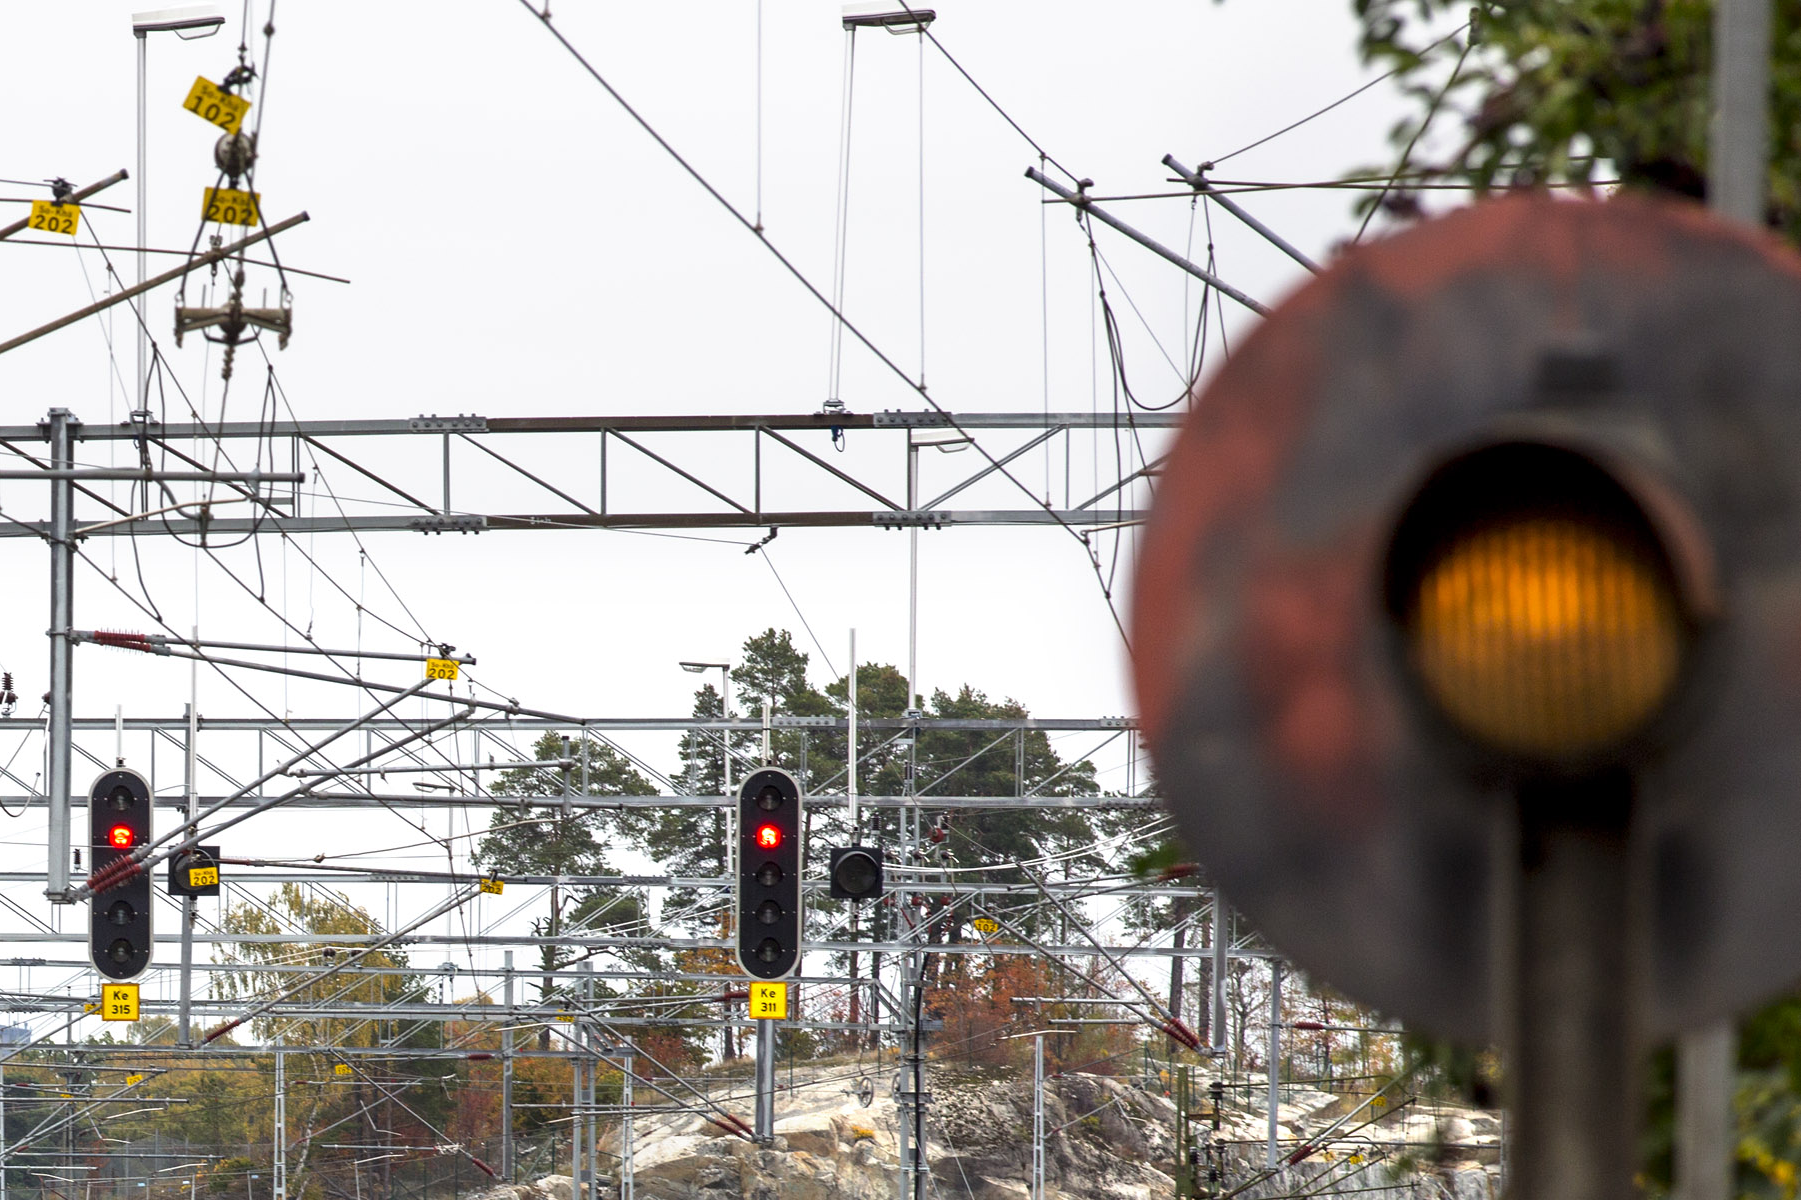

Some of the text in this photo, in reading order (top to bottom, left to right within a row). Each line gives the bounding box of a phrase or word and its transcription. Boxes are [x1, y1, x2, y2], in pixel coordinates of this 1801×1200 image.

[192, 96, 236, 130] 102
[207, 204, 254, 226] 202
[34, 214, 74, 234] 202
[429, 668, 455, 680] 202
[193, 876, 215, 885] 202
[481, 885, 501, 895] 202
[977, 923, 997, 932] 102
[113, 991, 129, 1001] Ke
[761, 988, 776, 998] Ke
[112, 1005, 130, 1014] 315
[761, 1003, 776, 1012] 311
